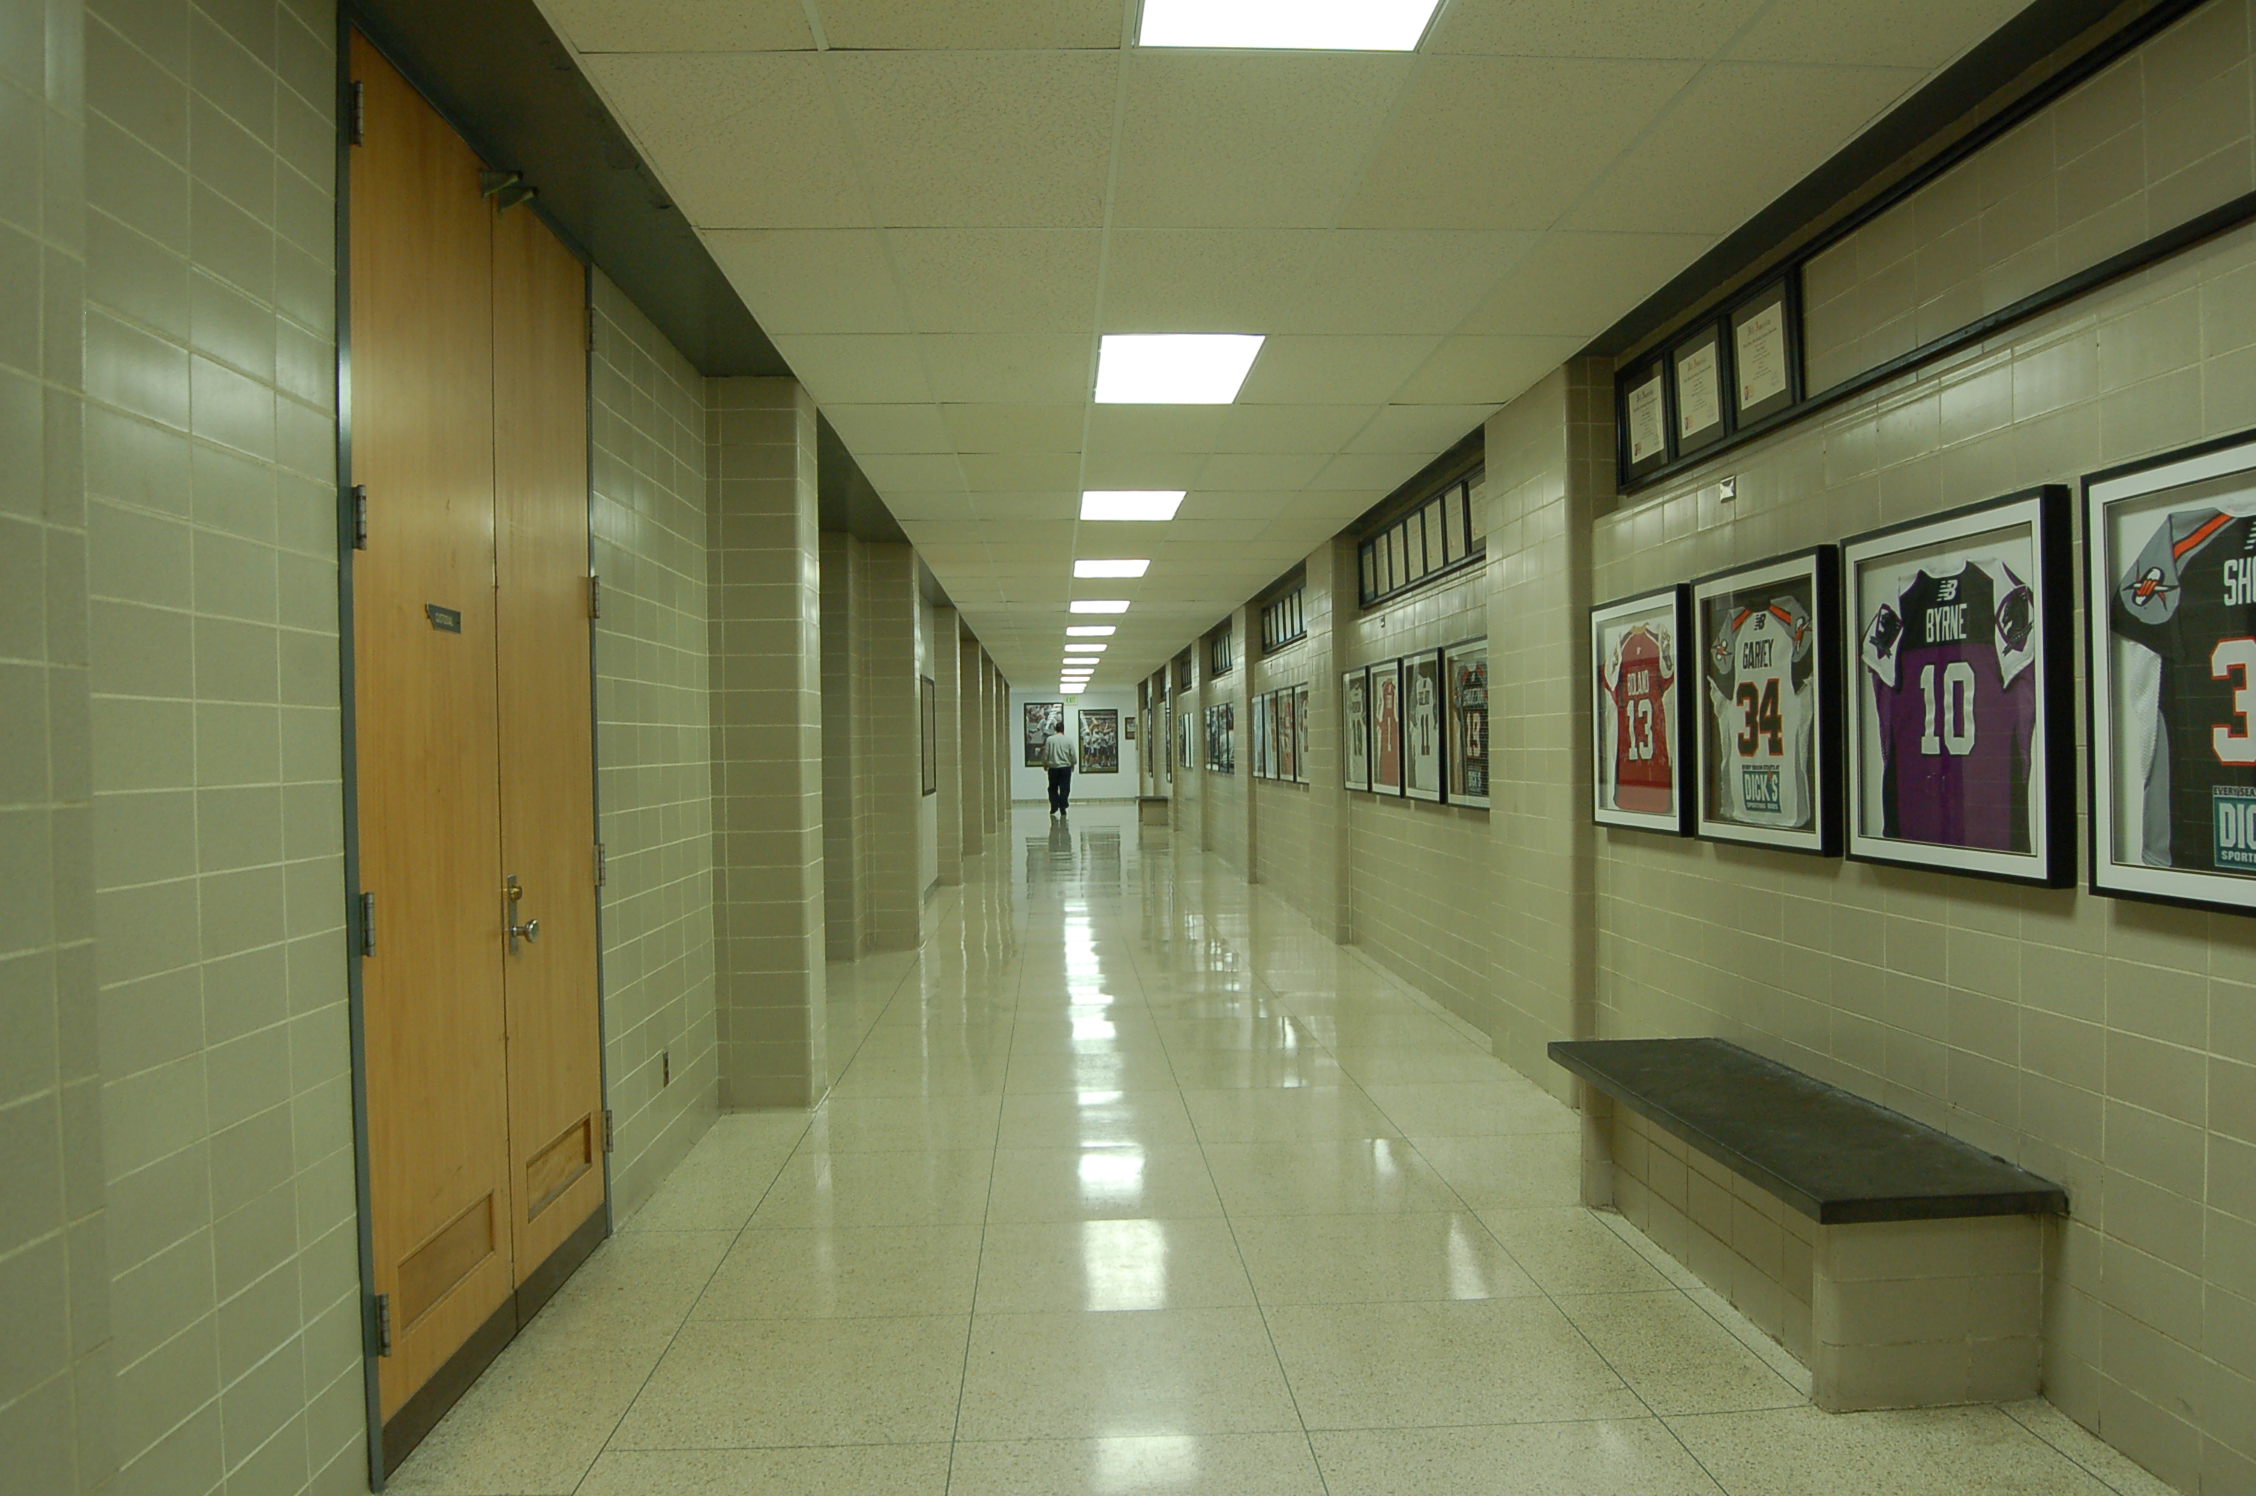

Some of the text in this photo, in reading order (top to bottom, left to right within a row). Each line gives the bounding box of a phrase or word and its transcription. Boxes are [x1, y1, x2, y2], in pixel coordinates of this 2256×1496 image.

[1926, 603, 1968, 644] BYRNE
[1743, 638, 1774, 670] GARVEY
[1627, 698, 1653, 761] 13
[1736, 677, 1784, 757] 34
[1919, 661, 1976, 756] 10
[1744, 772, 1779, 803] DICK'S
